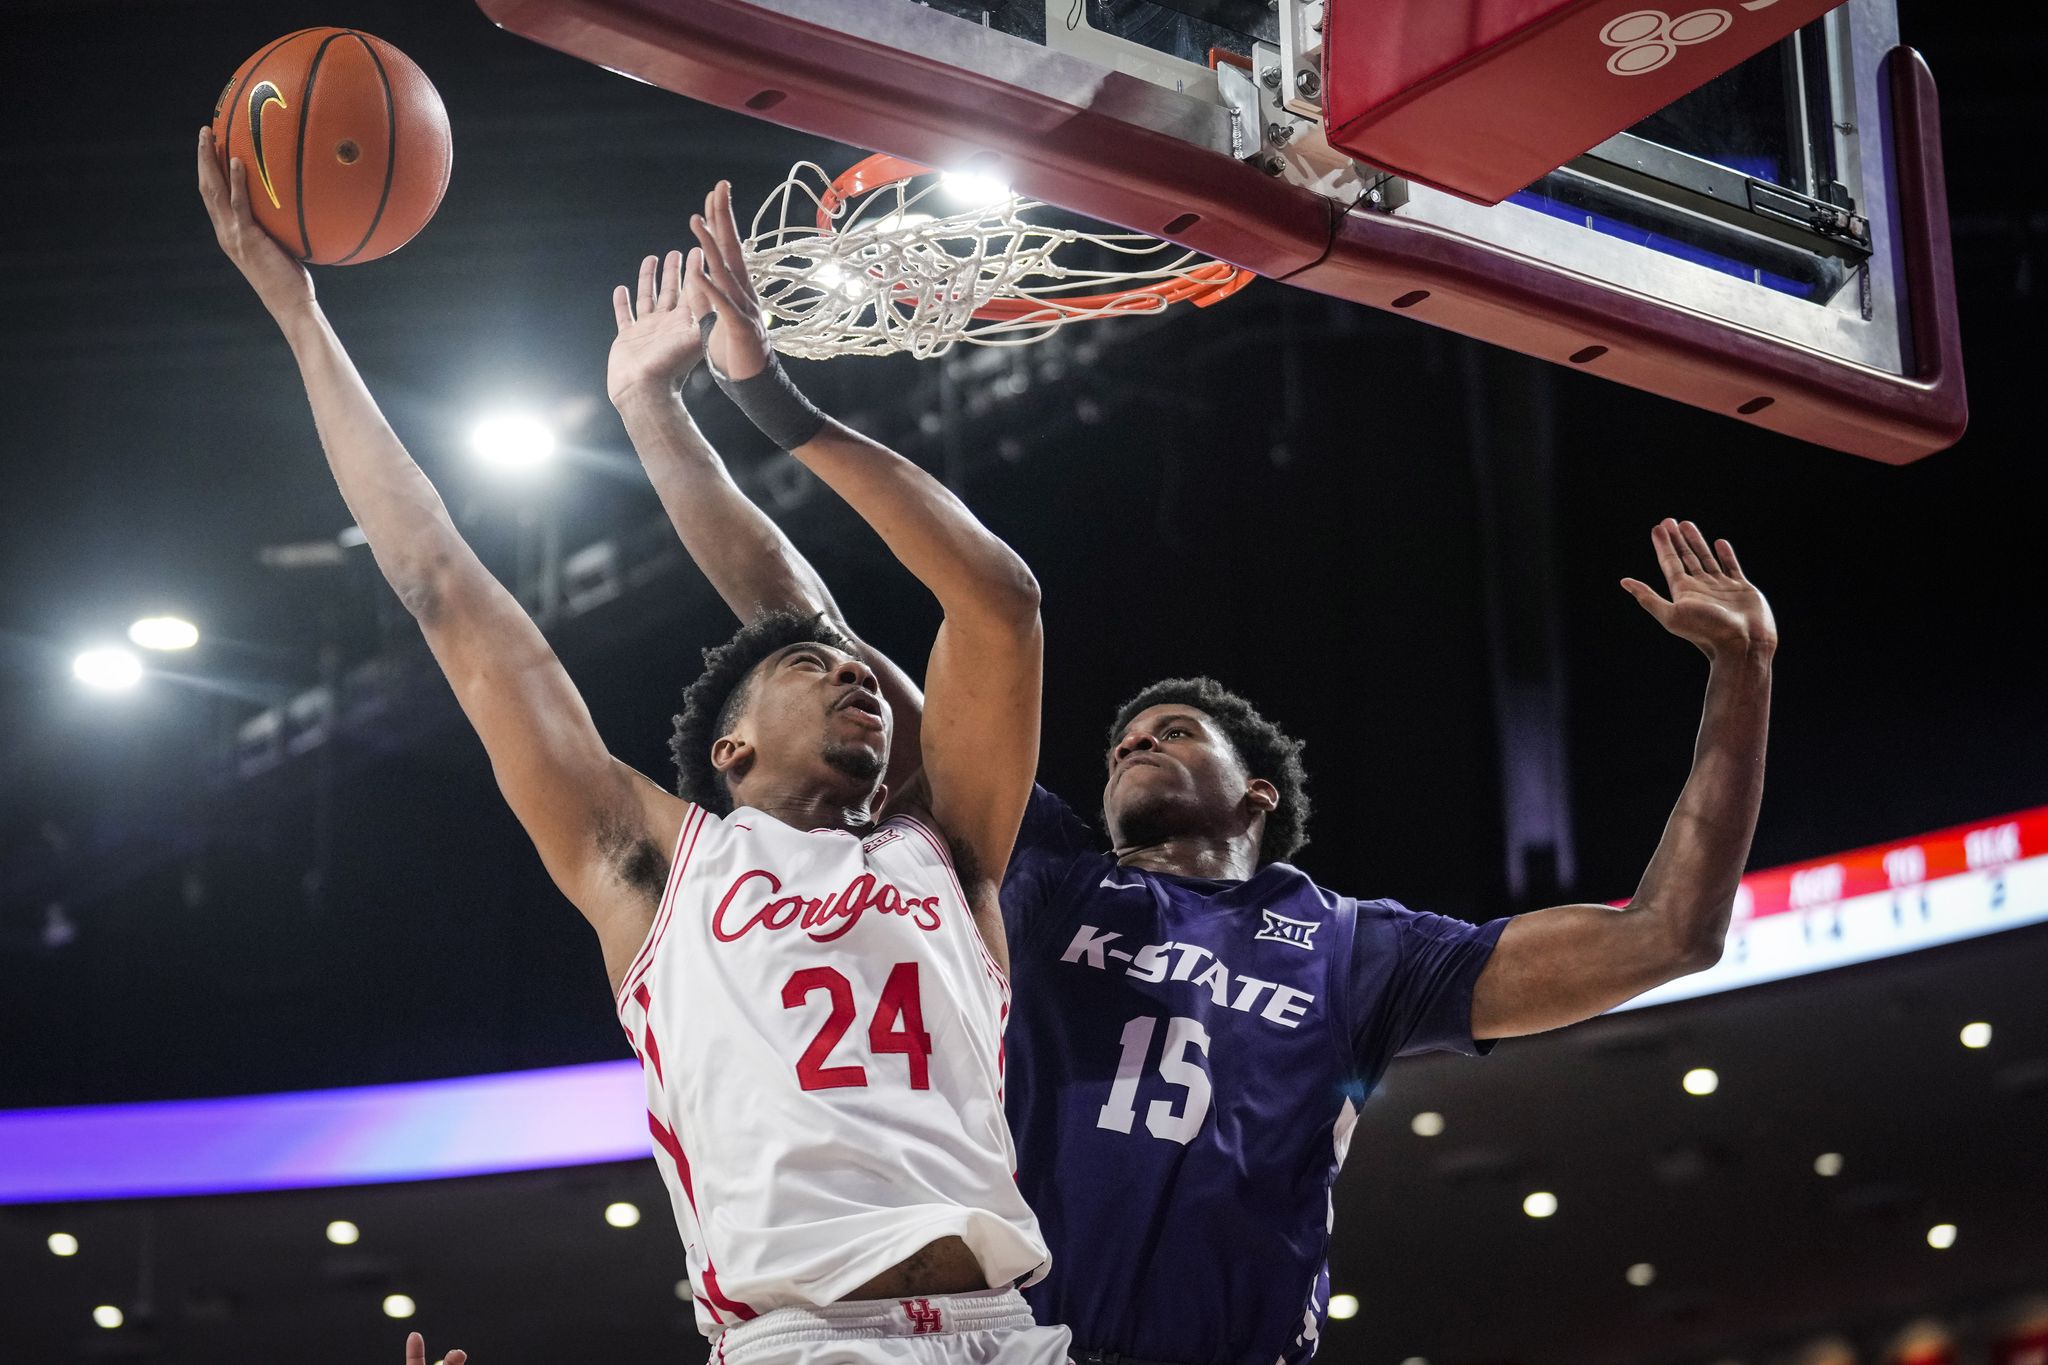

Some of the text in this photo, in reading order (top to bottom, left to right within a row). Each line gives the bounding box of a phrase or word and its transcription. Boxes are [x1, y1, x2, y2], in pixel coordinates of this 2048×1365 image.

[1060, 925, 1315, 1028] K-STATE
[1257, 910, 1318, 948] XII
[781, 961, 932, 1091] 24
[1096, 1016, 1211, 1146] 15
